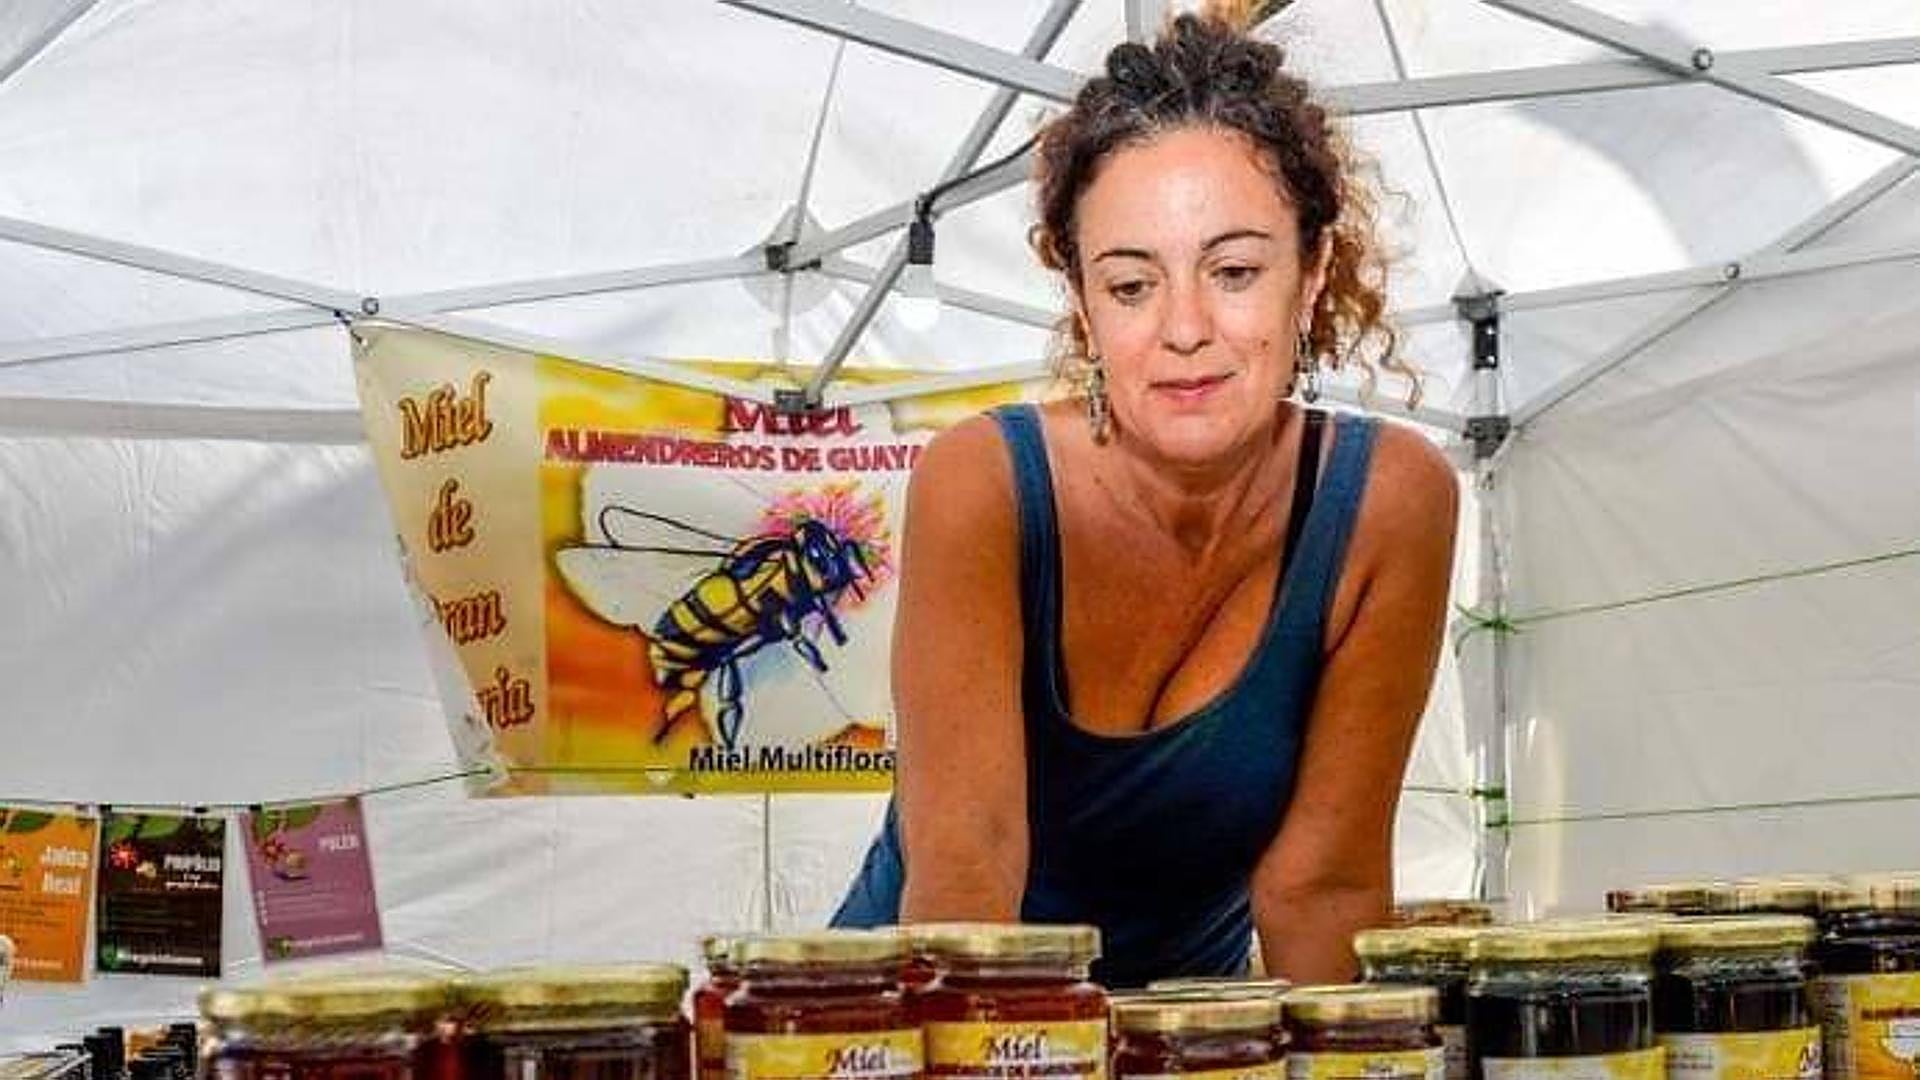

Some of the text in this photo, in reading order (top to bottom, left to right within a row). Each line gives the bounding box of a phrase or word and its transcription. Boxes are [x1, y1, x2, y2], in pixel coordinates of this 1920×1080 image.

[399, 371, 492, 459] Miel
[782, 445, 822, 472] DE
[428, 478, 475, 553] de
[433, 590, 507, 645] ran
[690, 745, 749, 771] Miel
